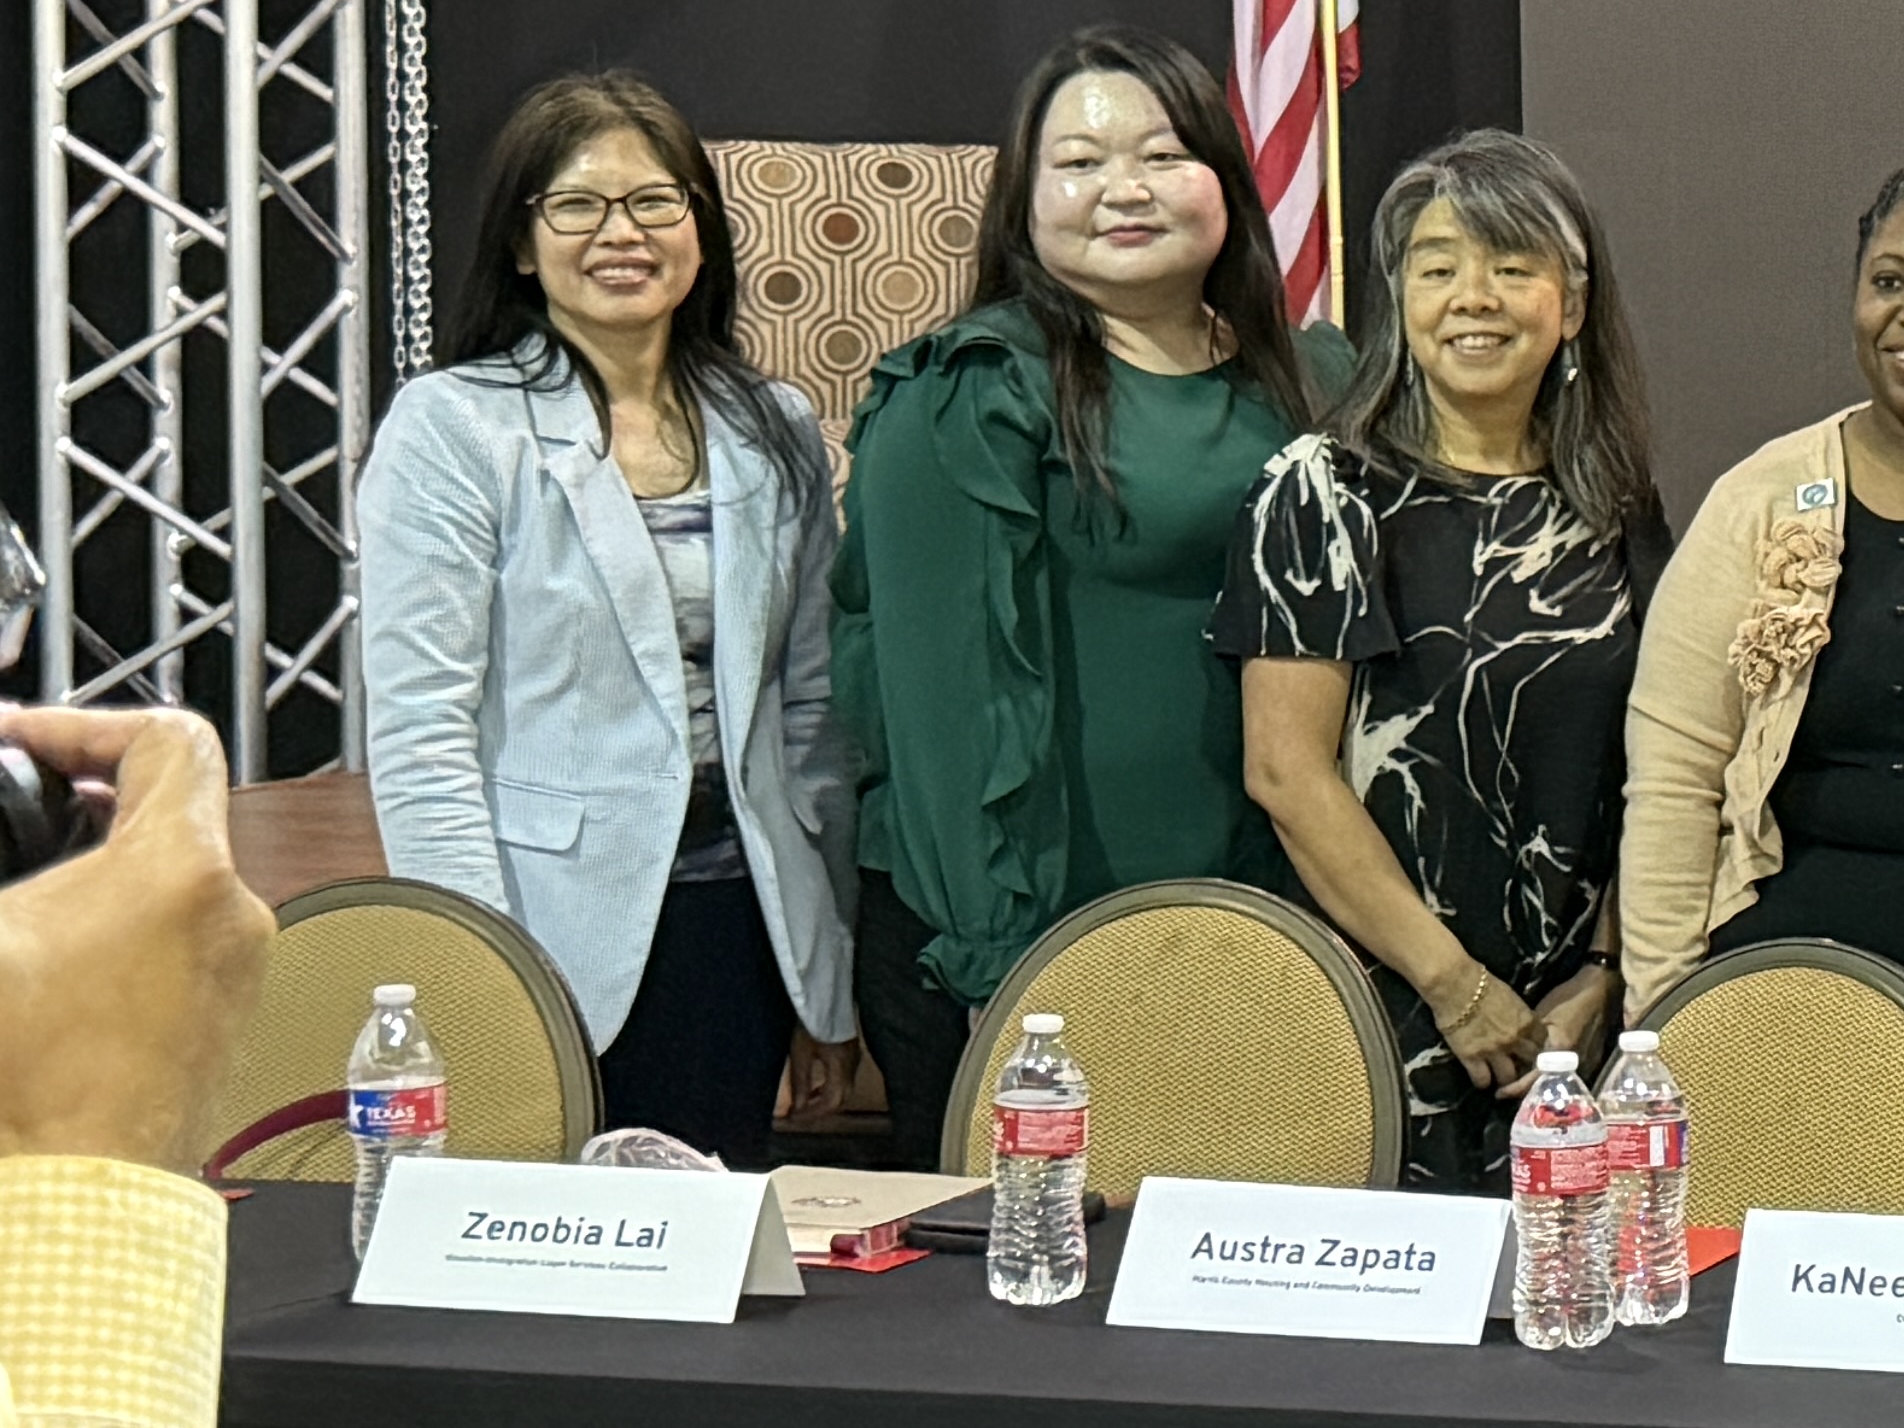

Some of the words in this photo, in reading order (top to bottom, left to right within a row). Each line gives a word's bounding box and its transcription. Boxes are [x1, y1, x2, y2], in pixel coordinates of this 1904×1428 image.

[461, 1211, 603, 1245] Zenobia
[614, 1219, 668, 1249] Lai
[1191, 1231, 1305, 1264] Austra
[1315, 1238, 1436, 1275] Zapata
